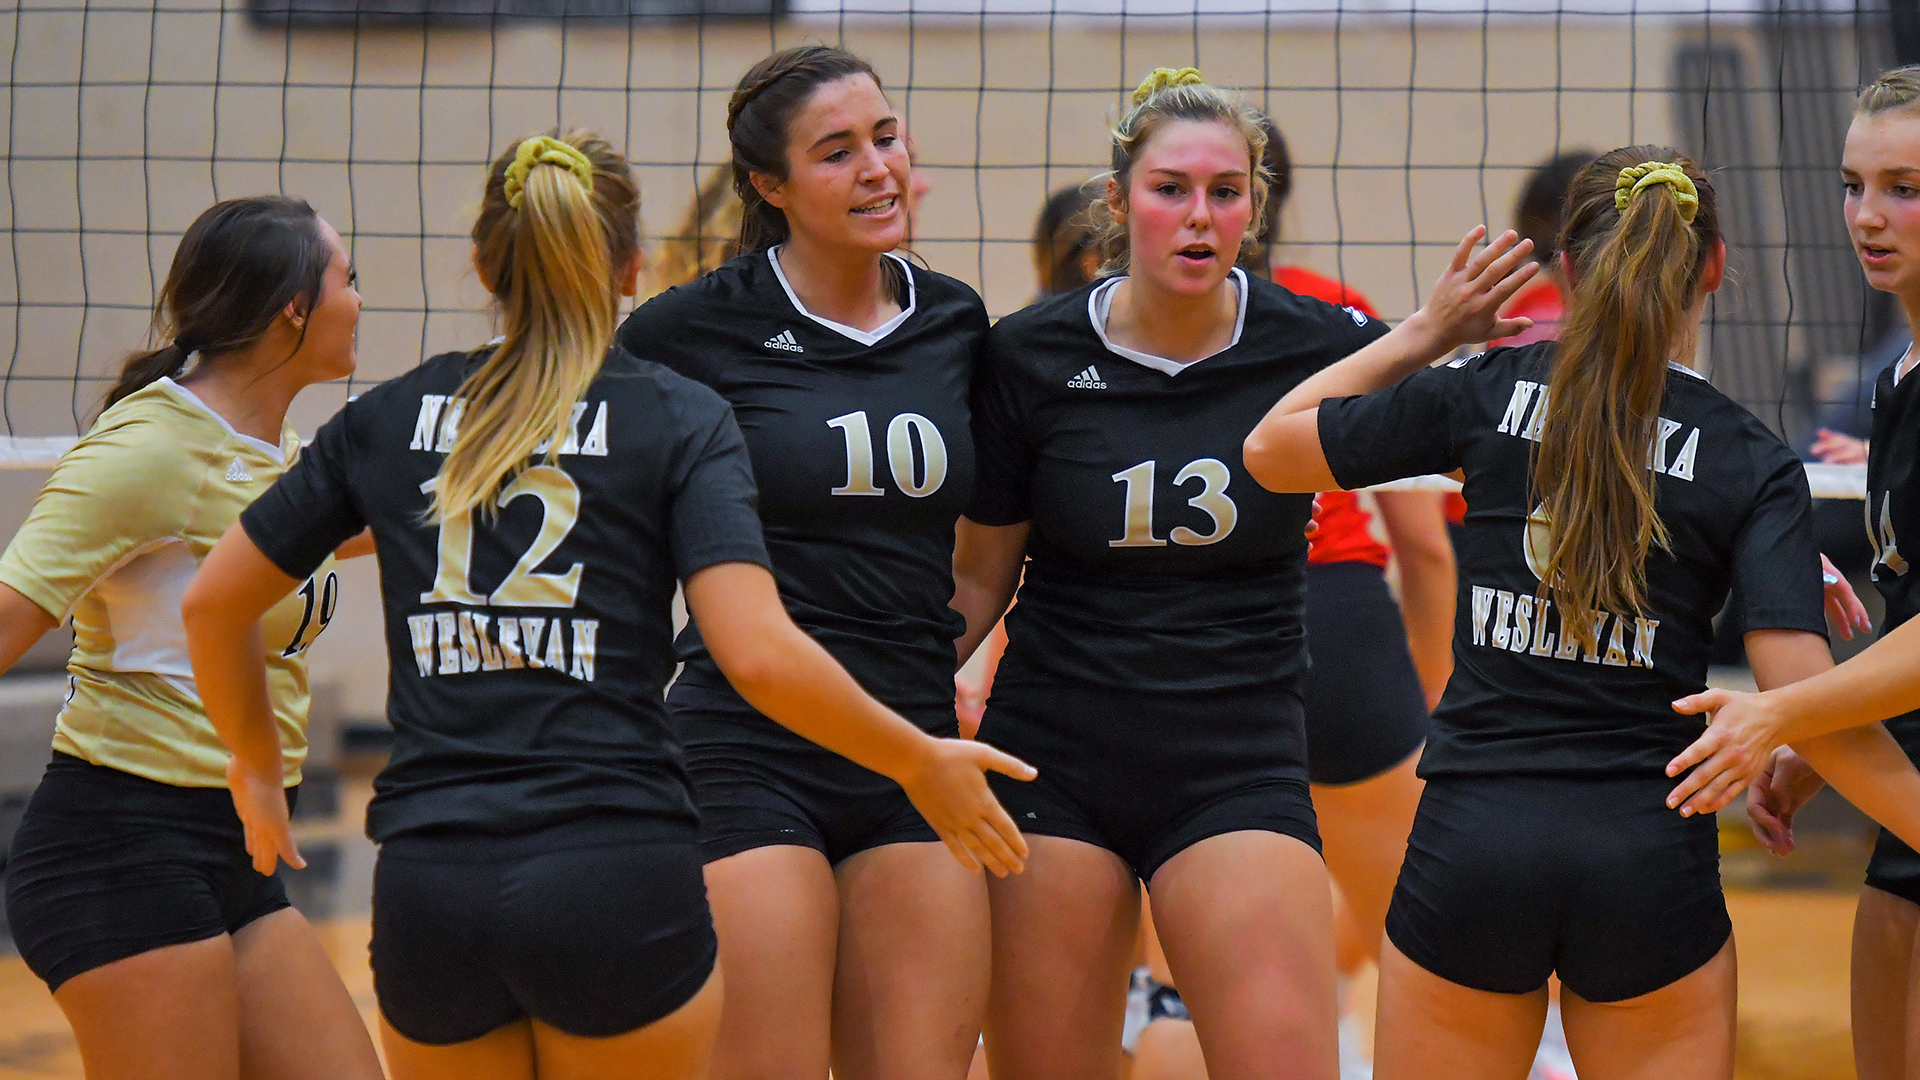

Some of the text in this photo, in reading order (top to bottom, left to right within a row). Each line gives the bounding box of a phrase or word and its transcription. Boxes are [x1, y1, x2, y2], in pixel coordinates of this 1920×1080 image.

[763, 341, 804, 353] adidas
[1067, 379, 1107, 390] adidas
[826, 411, 948, 498] 10
[418, 465, 585, 609] 12
[1108, 458, 1238, 547] 13
[281, 569, 338, 659] 19
[407, 612, 599, 682] WESLEYAN
